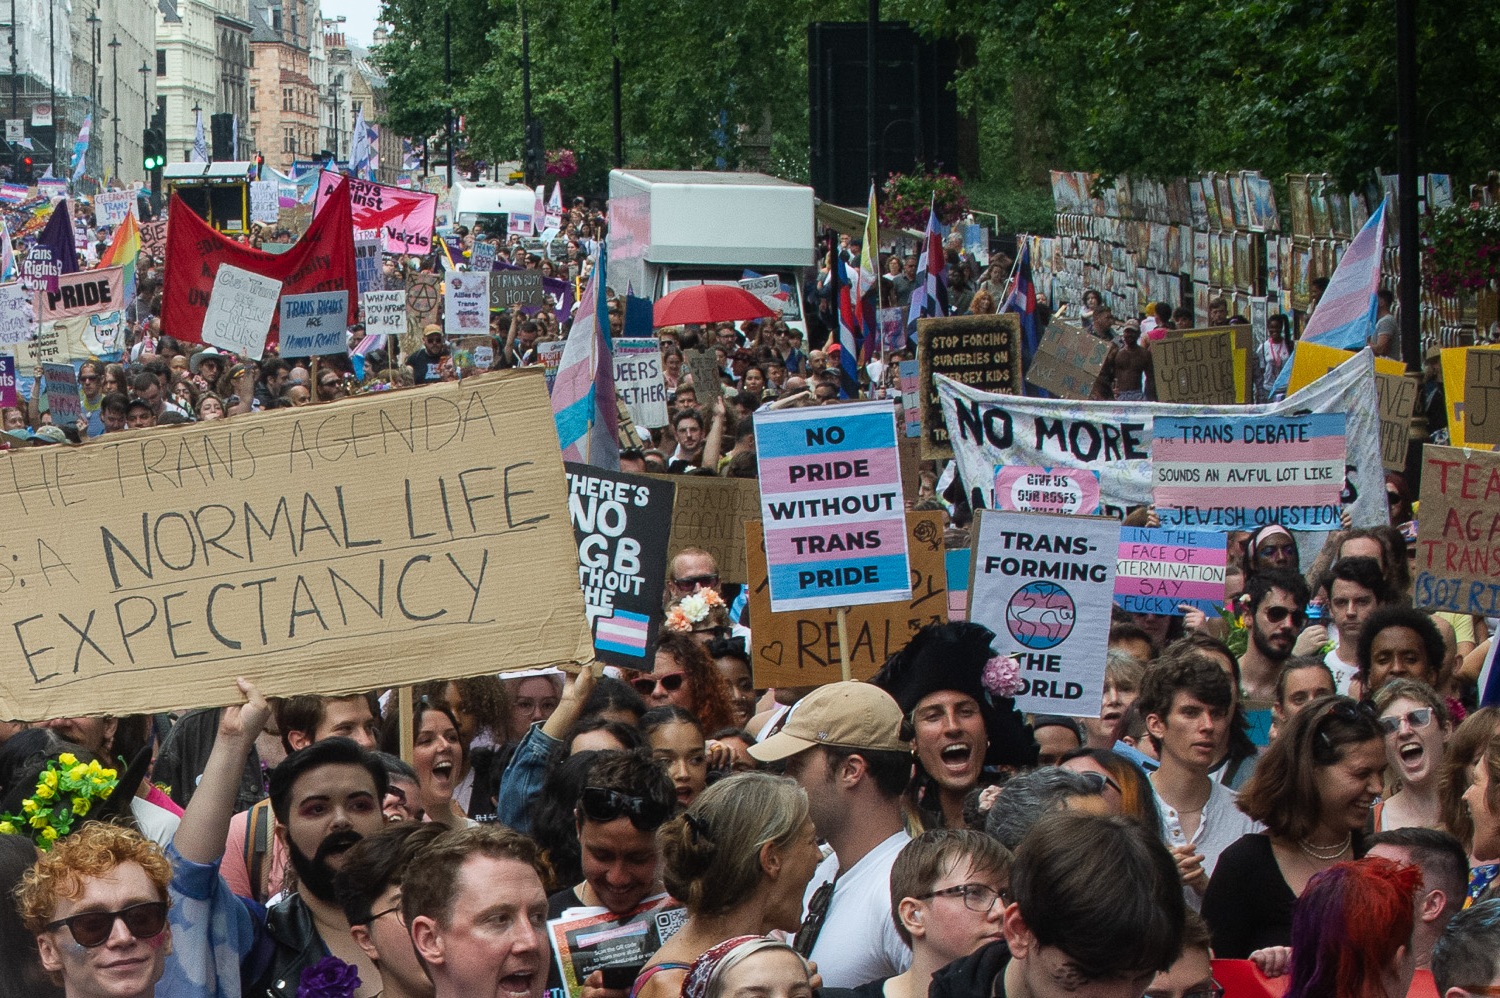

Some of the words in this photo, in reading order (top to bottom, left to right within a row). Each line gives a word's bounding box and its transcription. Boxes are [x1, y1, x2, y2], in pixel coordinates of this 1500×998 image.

[103, 201, 129, 213] TRANS
[386, 225, 430, 248] Nazis
[23, 261, 57, 278] Rights
[48, 279, 112, 311] PRIDE
[506, 290, 535, 304] HOLY
[367, 316, 380, 325] OF
[383, 315, 401, 328] US?
[214, 320, 260, 349] SLURS
[932, 336, 959, 349] STOP
[962, 332, 1008, 347] FORCING
[933, 352, 991, 366] SURGERIES
[993, 351, 1009, 363] ON
[1157, 339, 1204, 365] TIRED
[1209, 334, 1228, 359] OF
[986, 369, 1010, 381] KIDS
[1161, 364, 1211, 396] YOUR
[806, 425, 845, 447] NO
[953, 398, 1014, 450] NO
[1034, 416, 1148, 463] MORE
[101, 426, 260, 498] TRANS
[288, 389, 498, 475] AGENDA
[788, 458, 870, 484] PRIDE
[1027, 473, 1052, 487] GIVE
[1053, 475, 1069, 488] US
[1158, 468, 1200, 482] SOUNDS
[1205, 469, 1220, 482] AN
[1227, 468, 1272, 482] AWFUL
[1277, 467, 1300, 481] LOT
[1304, 466, 1333, 480] LIKE
[768, 492, 897, 520] WITHOUT
[1017, 489, 1041, 503] OUR
[1042, 491, 1077, 505] ROSES
[99, 485, 383, 588] NORMAL
[403, 460, 551, 541] LIFE
[568, 492, 627, 538] NO
[790, 530, 882, 555] TRANS
[1000, 531, 1098, 556] TRANS-
[1133, 528, 1152, 543] IN
[1163, 530, 1198, 545] THE
[1131, 545, 1168, 560] FACE
[1174, 548, 1198, 563] OF
[798, 565, 880, 590] PRIDE
[984, 555, 1107, 583] FORMING
[1139, 579, 1184, 596] SAY
[1124, 595, 1164, 613] FUCK
[12, 548, 490, 684] EXPECTANCY
[1011, 652, 1062, 673] THE
[1014, 679, 1083, 700] ORLD
